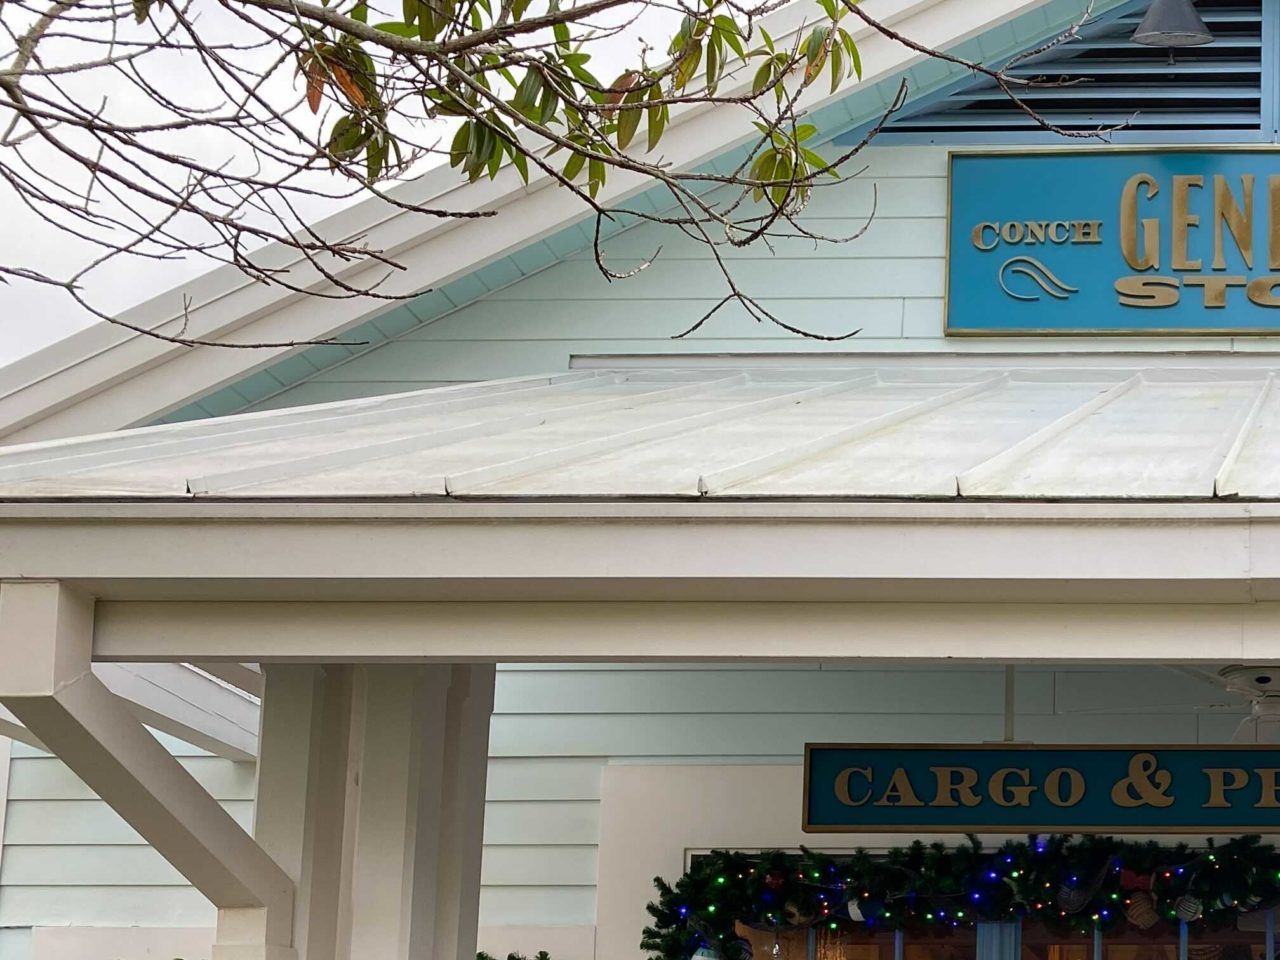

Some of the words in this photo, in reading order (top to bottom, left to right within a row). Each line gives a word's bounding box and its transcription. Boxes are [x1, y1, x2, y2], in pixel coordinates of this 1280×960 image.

[971, 220, 1103, 251] CONCH
[833, 766, 1087, 807] CARGO
[1110, 752, 1176, 808] &
